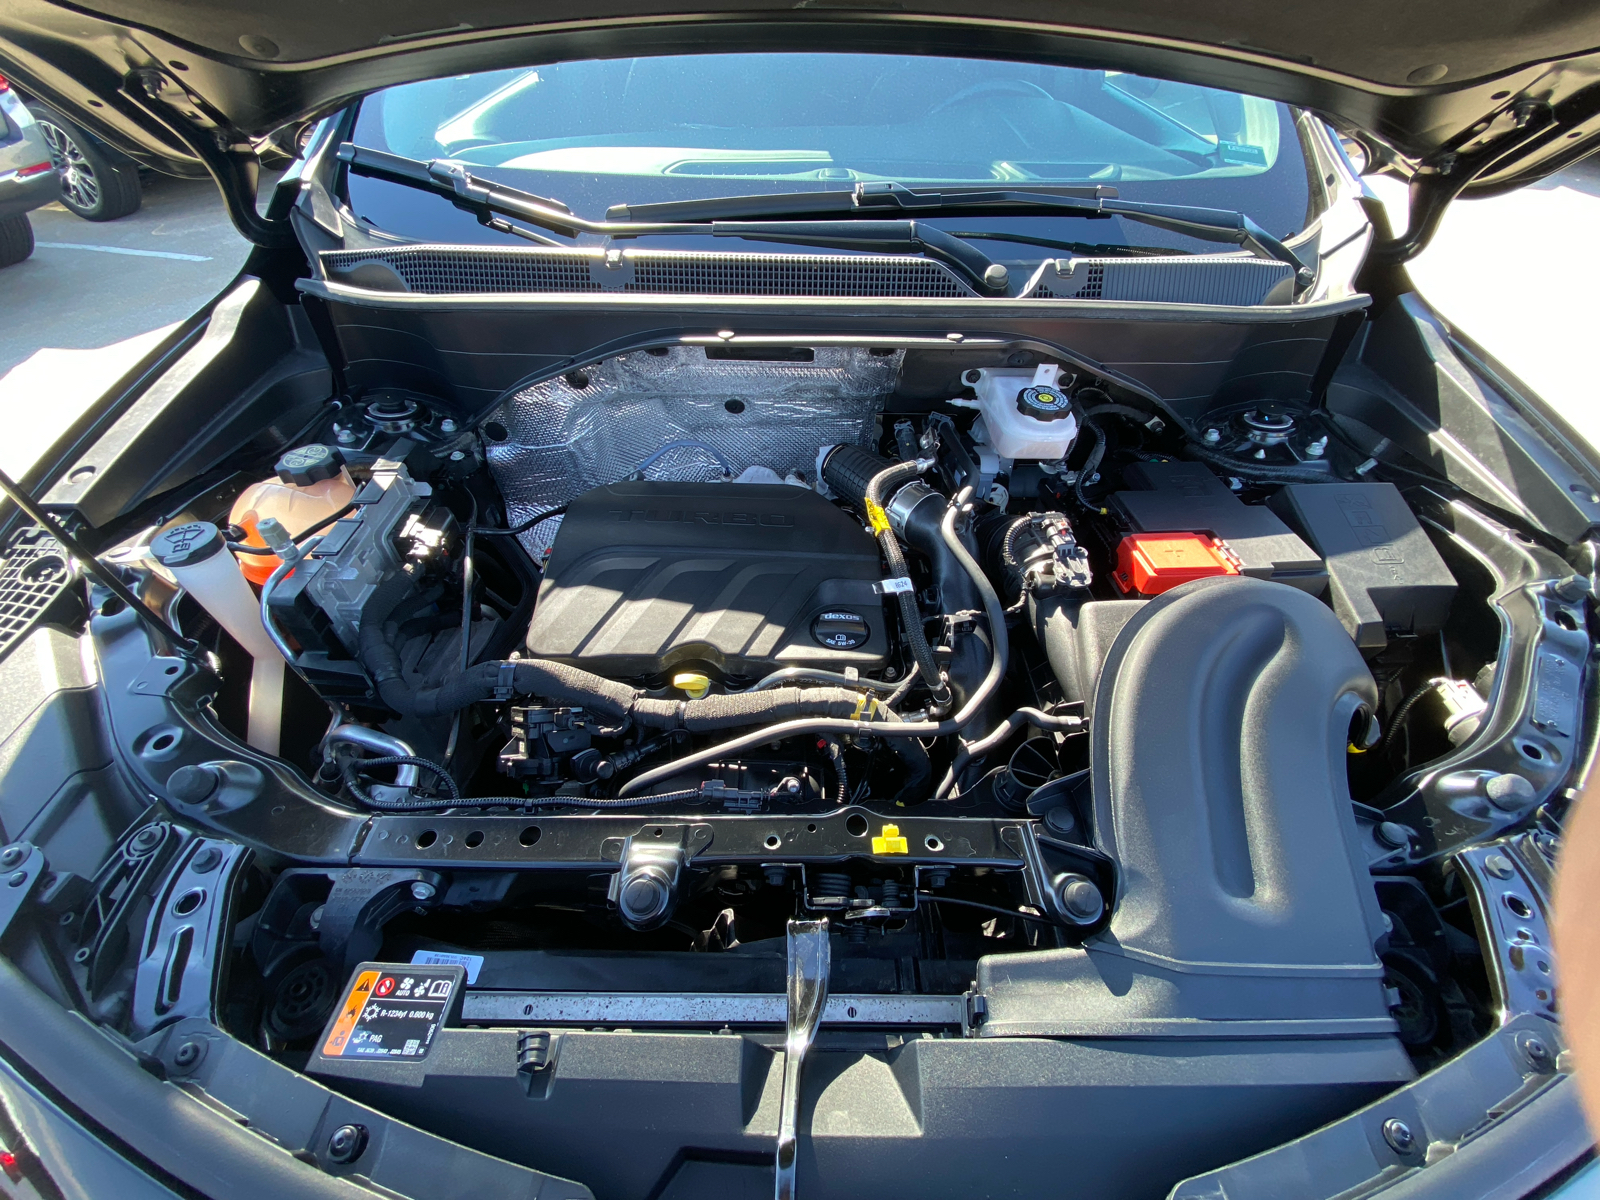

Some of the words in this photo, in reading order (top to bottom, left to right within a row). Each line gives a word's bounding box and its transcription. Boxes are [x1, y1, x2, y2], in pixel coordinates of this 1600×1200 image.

[608, 510, 795, 528] TURBO
[380, 1009, 407, 1018] R-1234yf
[426, 1011, 435, 1020] kg
[369, 1034, 382, 1042] PAG
